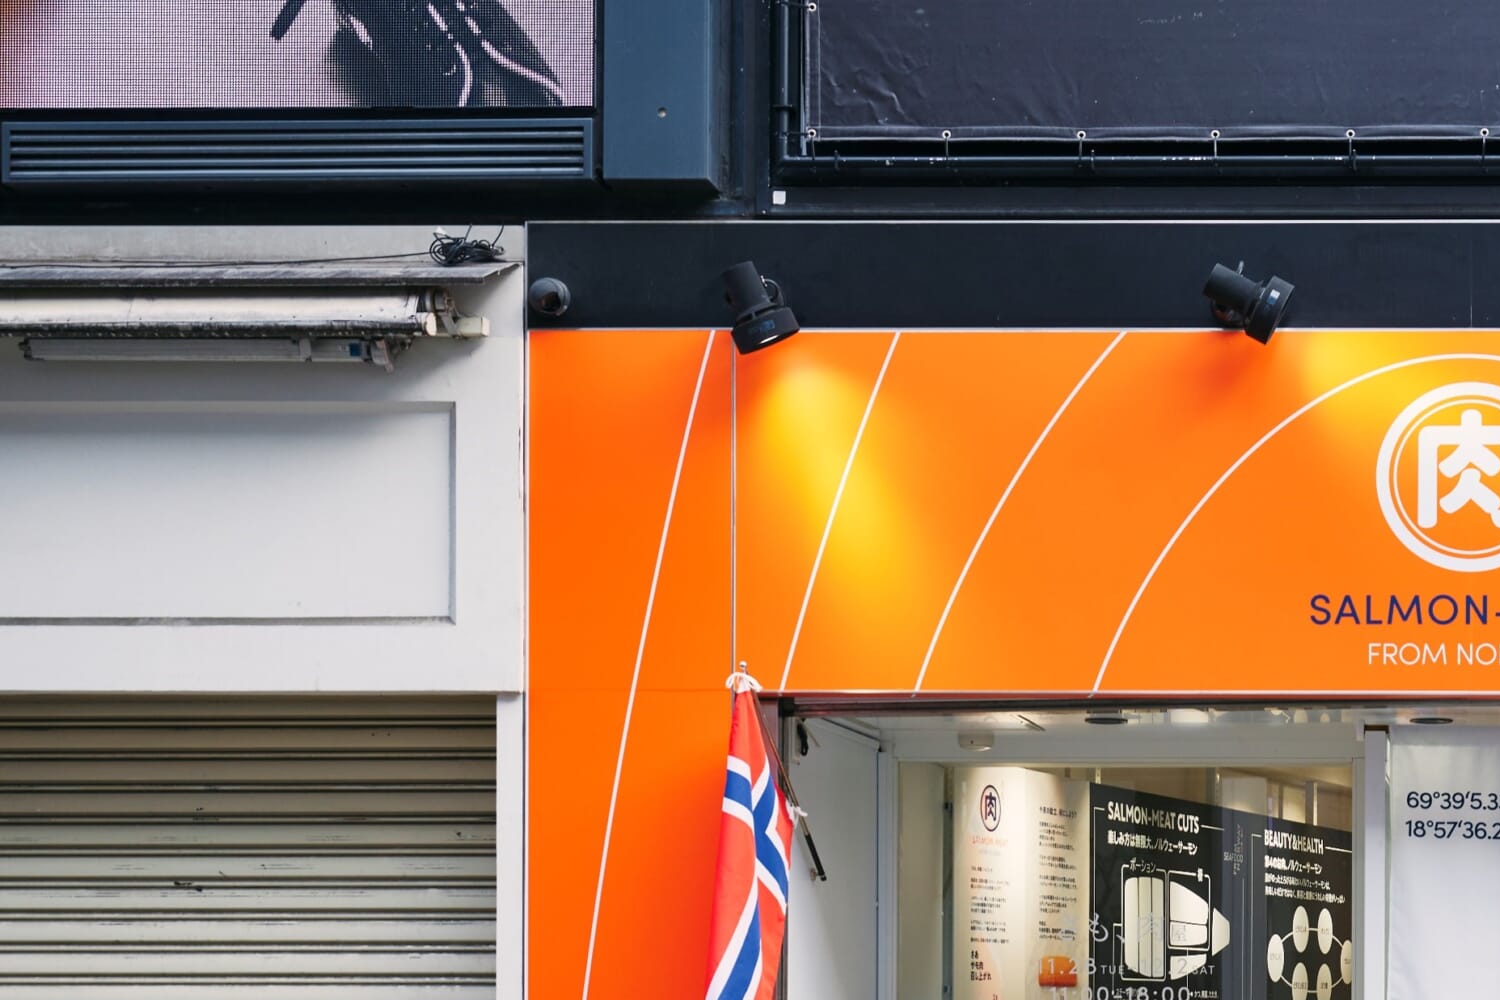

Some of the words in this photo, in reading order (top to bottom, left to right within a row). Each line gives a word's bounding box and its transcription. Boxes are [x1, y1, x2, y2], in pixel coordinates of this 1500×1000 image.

[1367, 643, 1448, 665] FROM
[1107, 801, 1176, 830] SALMON-MEAT
[1177, 813, 1200, 834] CUTS
[1264, 829, 1324, 855] BEAUTY&HEALTH
[1129, 857, 1156, 873] ポーション
